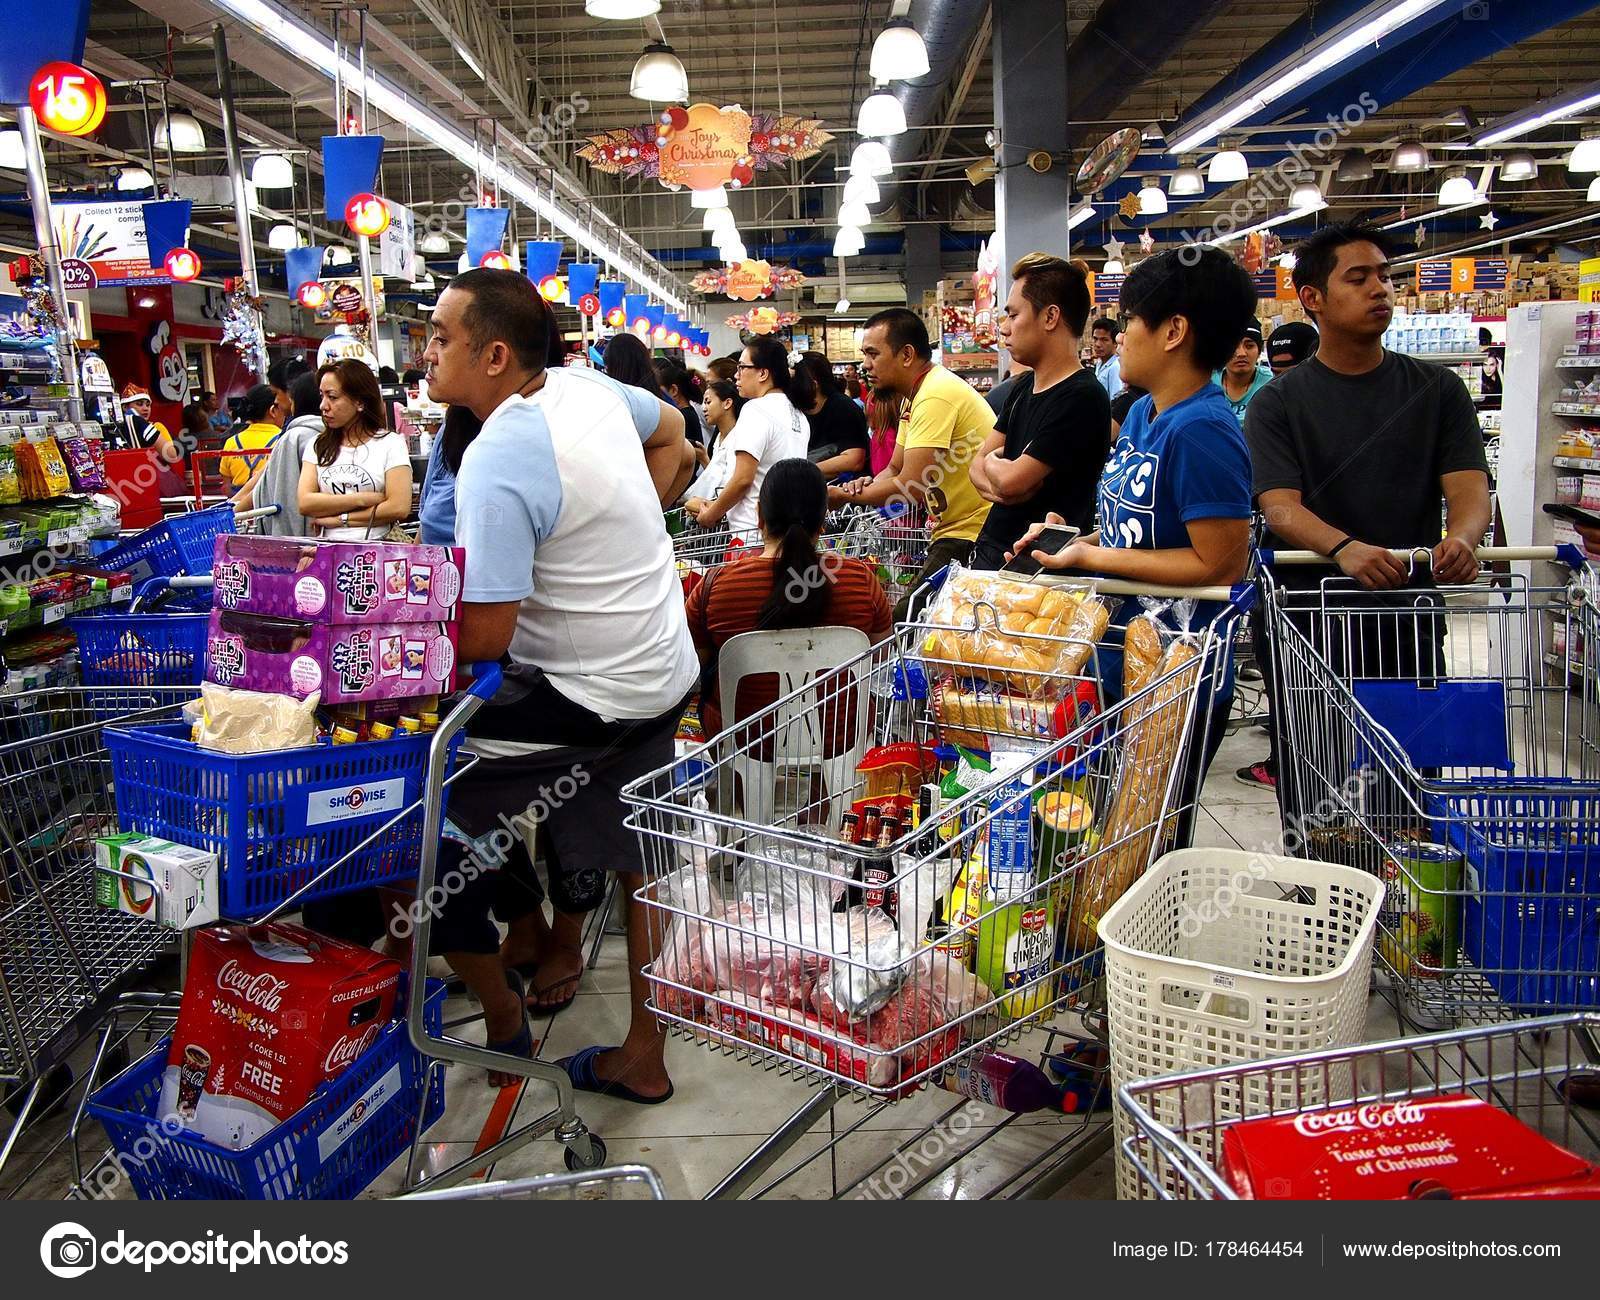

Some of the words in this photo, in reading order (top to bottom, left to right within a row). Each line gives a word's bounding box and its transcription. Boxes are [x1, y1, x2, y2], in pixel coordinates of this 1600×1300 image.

[36, 76, 87, 121] 15
[690, 128, 720, 148] Joys
[671, 144, 739, 161] Christmas
[85, 207, 112, 216] Collect
[1282, 276, 1293, 289] 2
[1458, 268, 1469, 282] 3
[585, 298, 593, 311] 8
[321, 466, 372, 486] ARMANI
[680, 725, 703, 735] HAPPY
[329, 787, 386, 809] SHOPWISE
[862, 869, 889, 881] MIRNOFF
[217, 959, 290, 1013] Coca-Cola
[332, 988, 363, 1003] COLLECT
[363, 985, 374, 996] ALL
[248, 1041, 254, 1050] 4
[254, 1043, 273, 1059] COKE
[274, 1052, 288, 1065] 1.5L
[258, 1058, 272, 1071] with
[241, 1061, 283, 1096] FREE
[234, 1081, 264, 1102] Christmas
[265, 1097, 284, 1111] Glass
[336, 1084, 386, 1136] SHOPWISE
[1294, 1100, 1426, 1137] Coca-Cola
[1328, 1149, 1376, 1163] Taste
[1377, 1143, 1404, 1158] the
[1406, 1137, 1455, 1153] magic
[1355, 1161, 1375, 1176] of
[1375, 1152, 1459, 1173] Christmas
